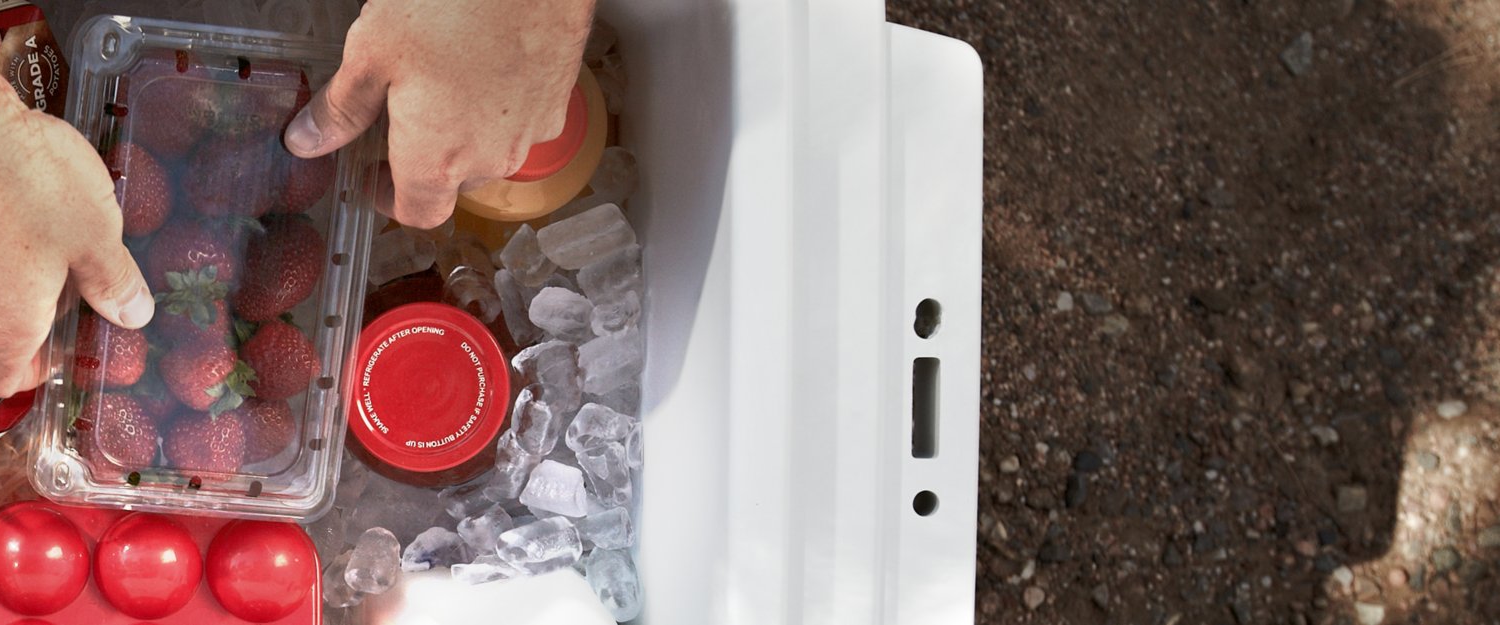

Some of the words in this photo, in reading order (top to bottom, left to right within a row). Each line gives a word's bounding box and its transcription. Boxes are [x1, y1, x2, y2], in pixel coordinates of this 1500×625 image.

[25, 35, 37, 48] A
[9, 55, 20, 77] WITH
[43, 45, 60, 96] POTATOES
[28, 52, 47, 112] GRADE
[388, 328, 411, 344] AFTER
[411, 326, 445, 336] OPENING
[460, 341, 472, 353] DO
[362, 340, 389, 387] REFRIGERATE
[468, 351, 480, 367] NOT
[475, 367, 486, 408] PURCHASE
[363, 391, 375, 413] WELL
[369, 411, 390, 434] SHAKE
[455, 414, 478, 438] SAFETY
[426, 434, 456, 448] BUTTON
